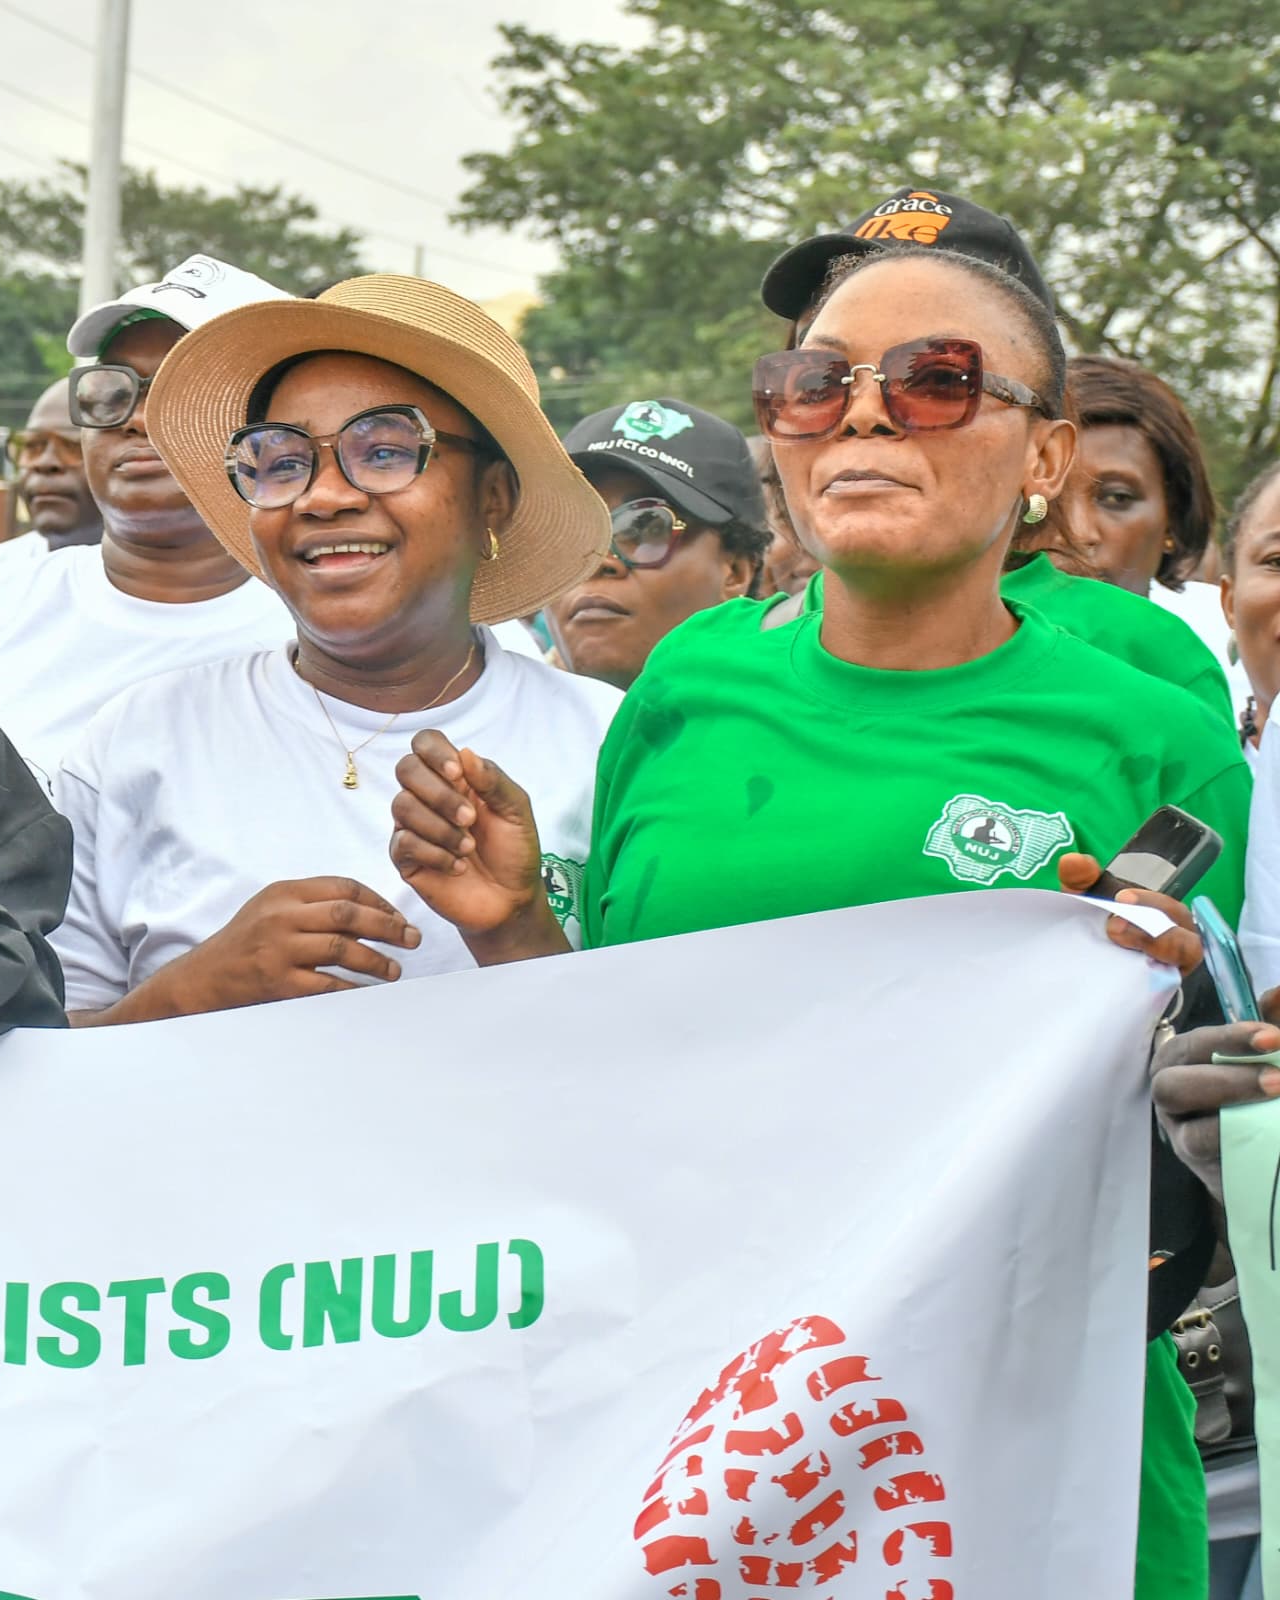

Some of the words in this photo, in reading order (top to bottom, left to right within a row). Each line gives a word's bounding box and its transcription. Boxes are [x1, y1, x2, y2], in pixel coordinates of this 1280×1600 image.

[873, 198, 953, 217] Grace
[964, 842, 1001, 861] NUJ
[547, 896, 565, 909] UJ
[259, 1239, 545, 1350] (NUJ)
